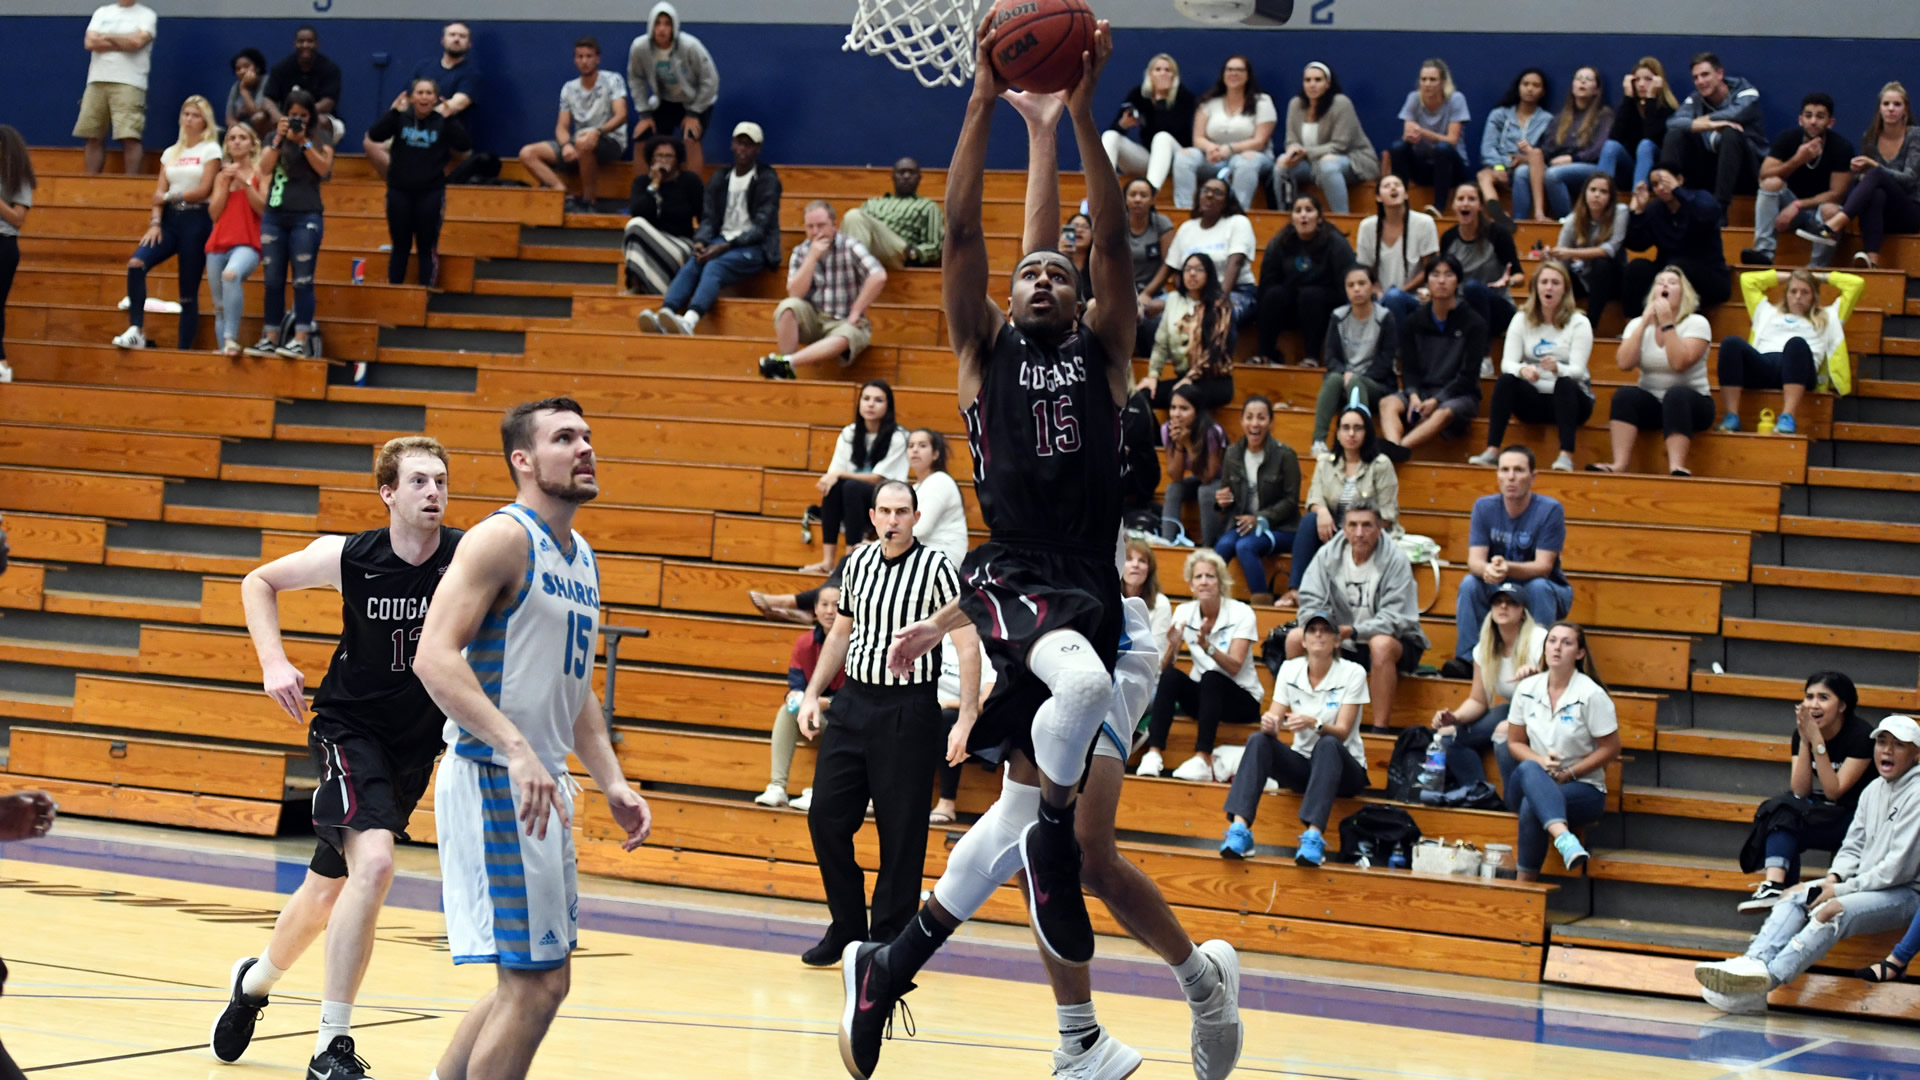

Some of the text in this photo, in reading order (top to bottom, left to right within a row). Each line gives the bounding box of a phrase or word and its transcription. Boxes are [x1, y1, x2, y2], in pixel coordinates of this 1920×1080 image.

[991, 2, 1037, 28] ilson
[997, 31, 1038, 67] NCAA
[1032, 395, 1081, 456] 15
[367, 596, 429, 620] COUGA
[563, 610, 592, 680] 15
